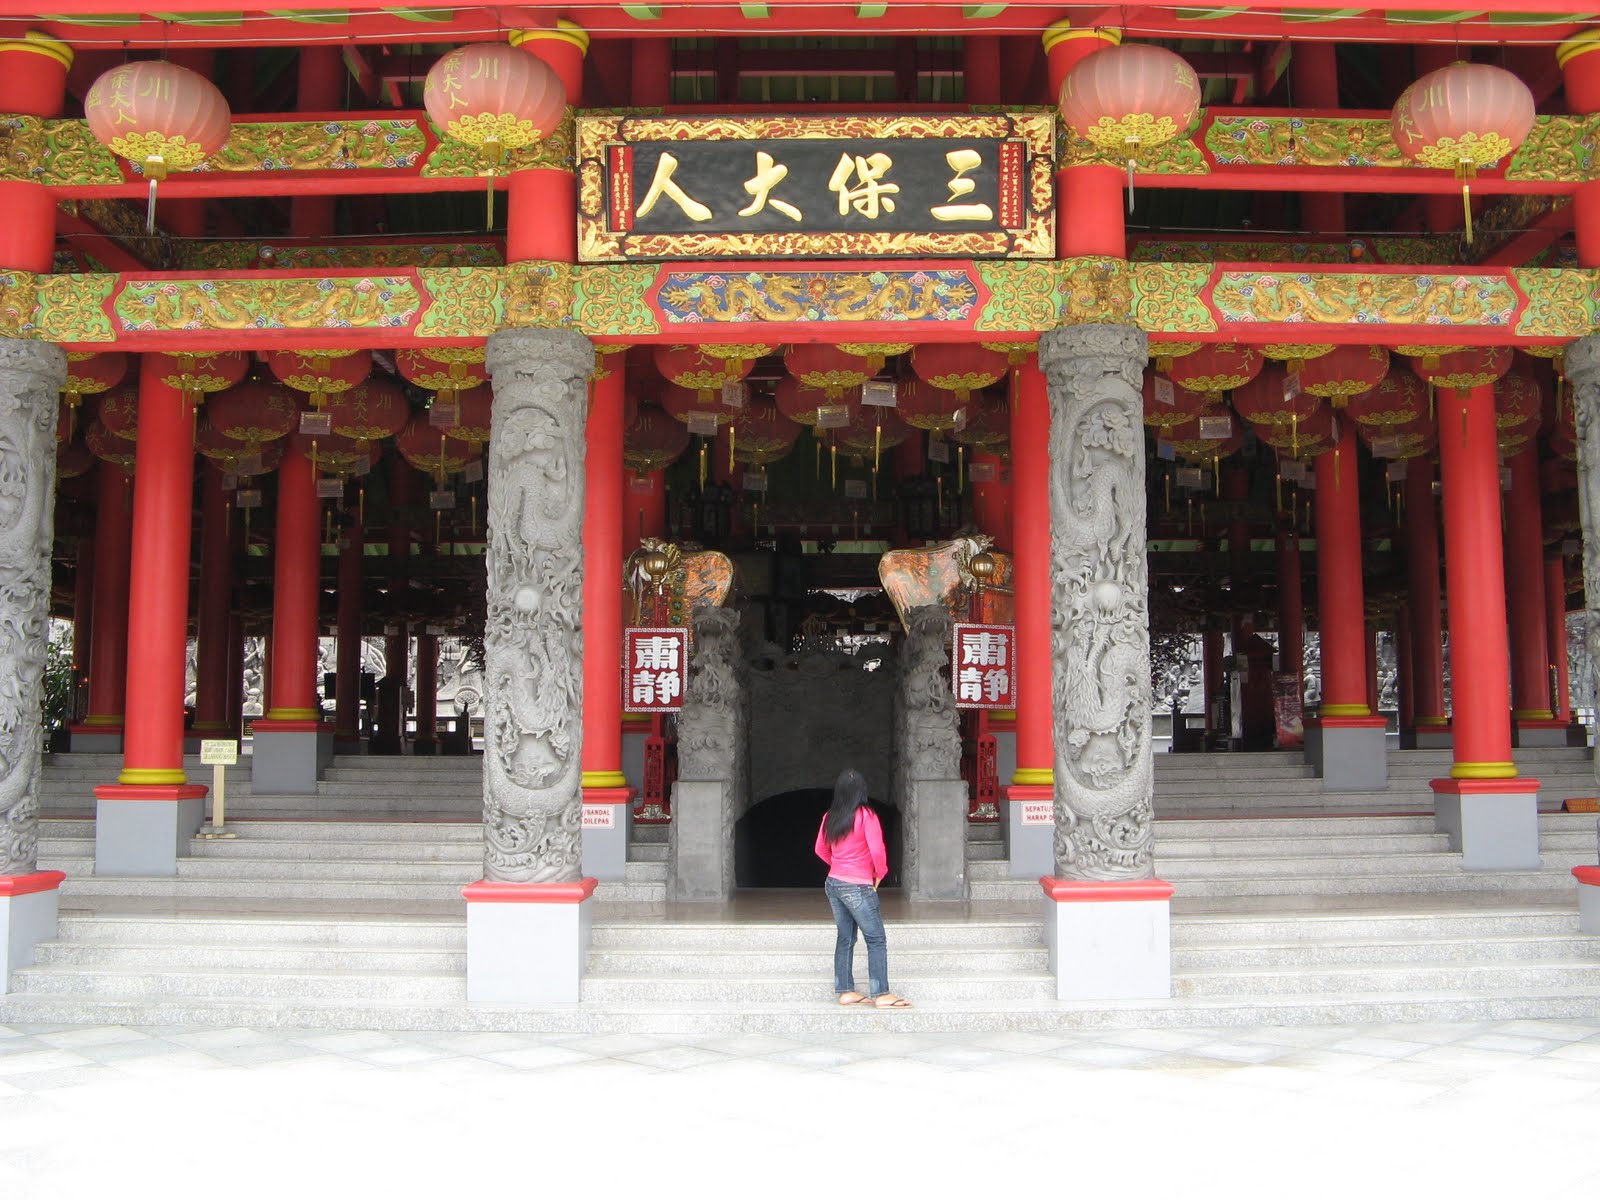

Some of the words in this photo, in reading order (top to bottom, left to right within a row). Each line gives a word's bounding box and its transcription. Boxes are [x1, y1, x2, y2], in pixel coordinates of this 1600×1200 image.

[635, 149, 993, 222] 三保大人
[584, 817, 609, 825] DILEPAS
